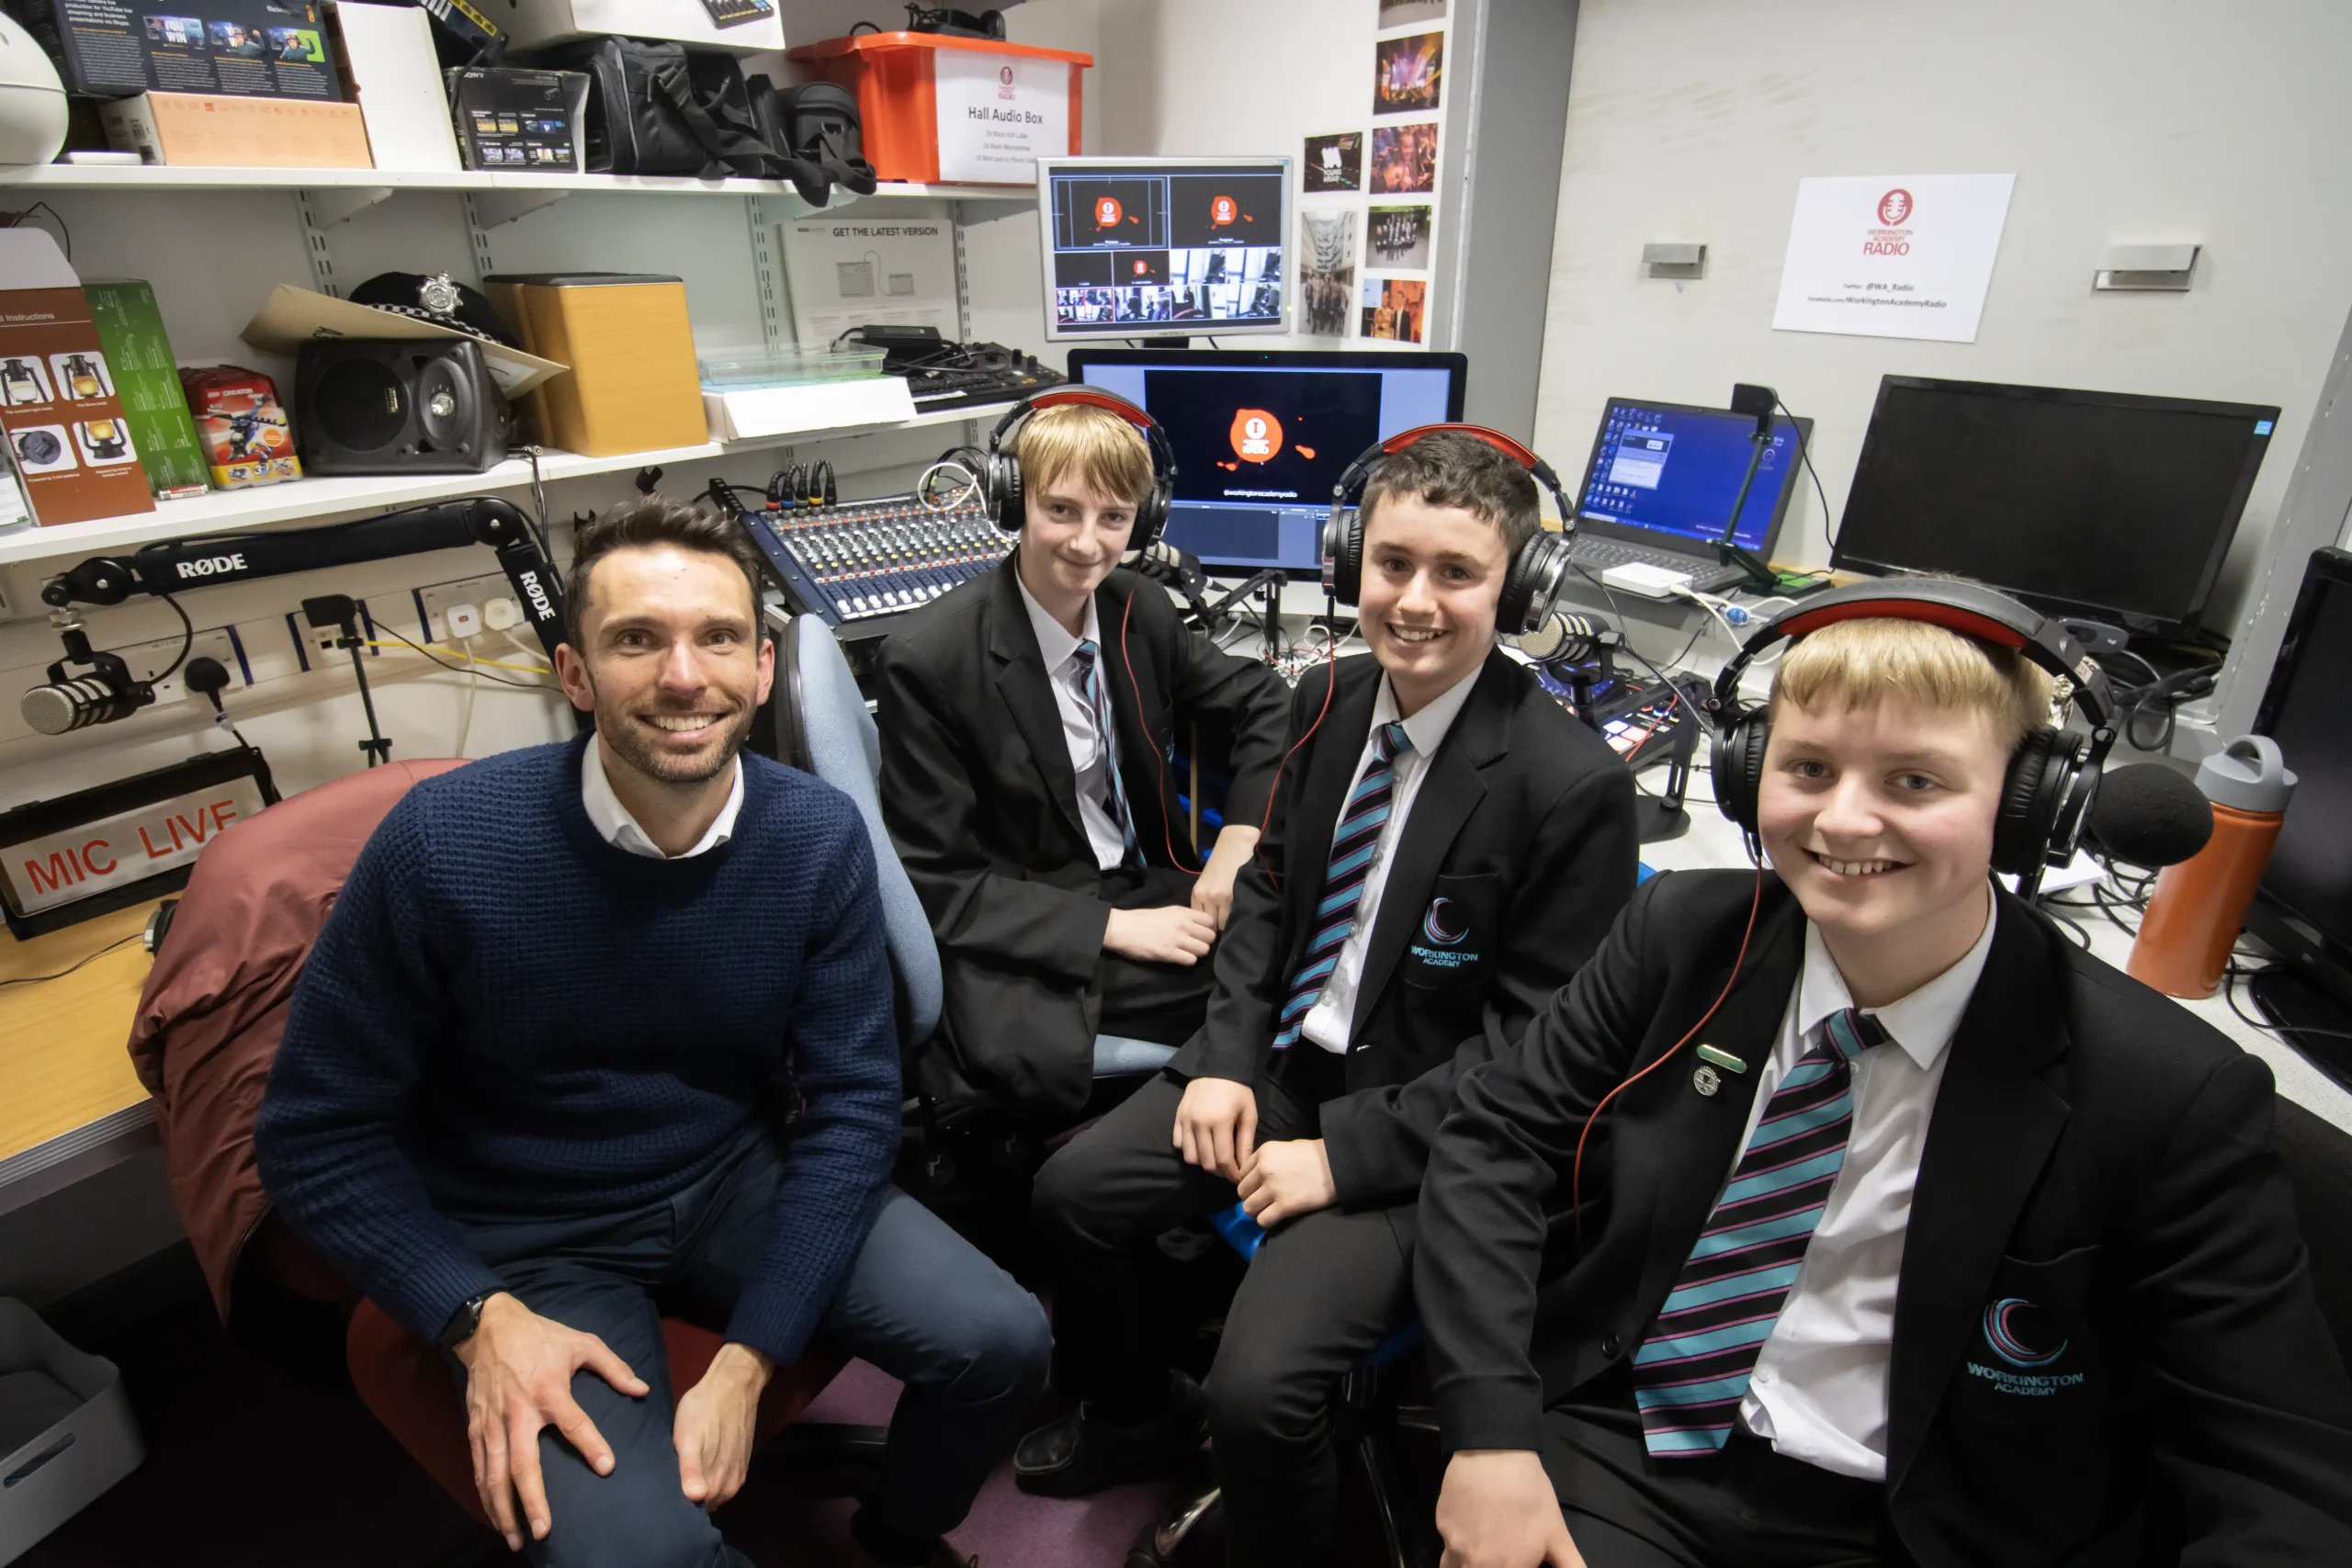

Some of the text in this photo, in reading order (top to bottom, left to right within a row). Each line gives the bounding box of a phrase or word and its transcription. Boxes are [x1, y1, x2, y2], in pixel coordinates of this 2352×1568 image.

[166, 31, 187, 43] WIN
[968, 106, 1044, 125] Hall Audio Box
[832, 228, 849, 237] GET
[853, 227, 868, 236] THE
[871, 227, 899, 236] LATEST
[902, 227, 938, 236] VERSION
[1863, 242, 1910, 255] RADIO
[1866, 282, 1914, 293] @WA_Radio
[6, 312, 55, 321] Instructions
[175, 553, 248, 579] RØDE
[519, 570, 556, 622] RØDE
[24, 799, 237, 896] MIC LIVE
[1411, 945, 1478, 962] WORKINGTON
[1422, 957, 1461, 967] ACADEMY
[1967, 1361, 2084, 1387] WORKINGTON
[1994, 1382, 2056, 1396] ACADEMY
